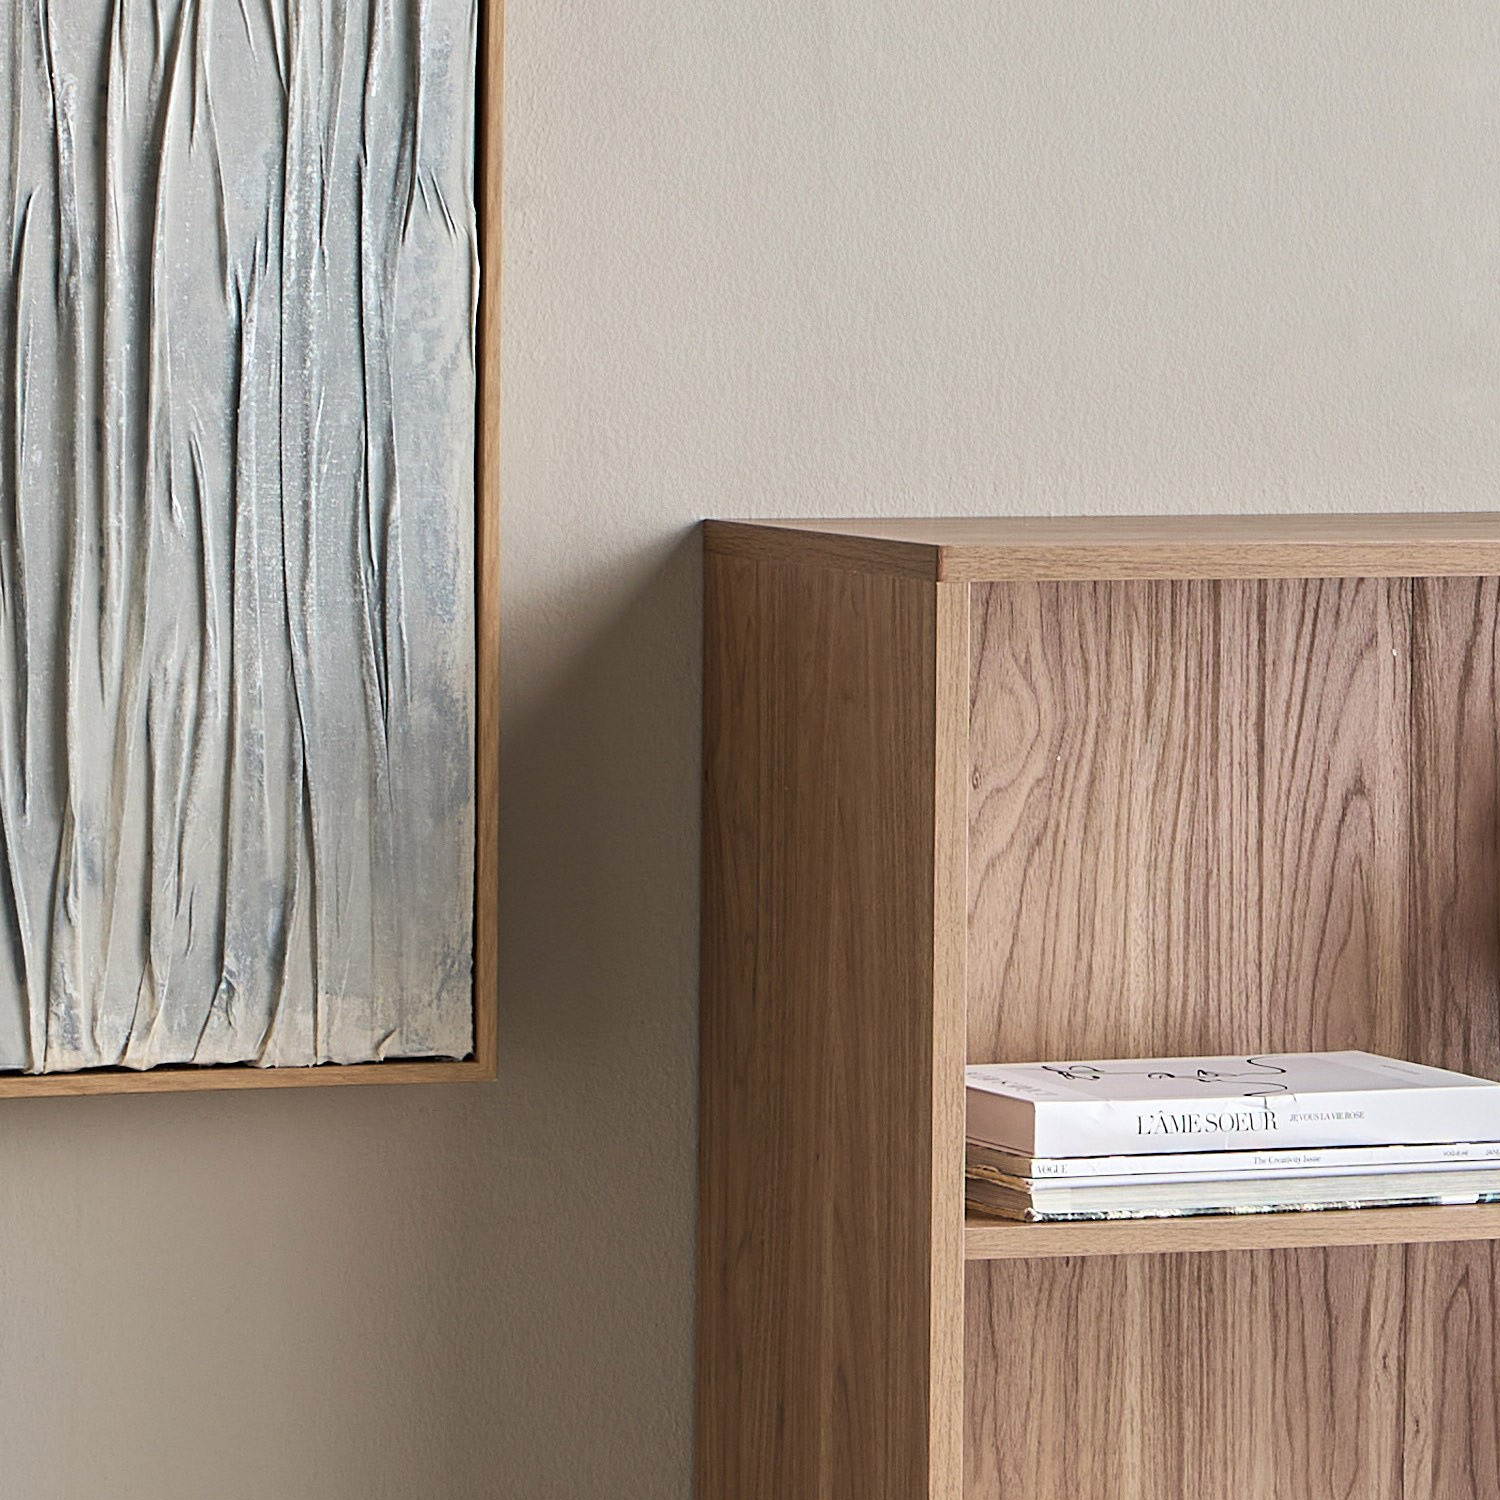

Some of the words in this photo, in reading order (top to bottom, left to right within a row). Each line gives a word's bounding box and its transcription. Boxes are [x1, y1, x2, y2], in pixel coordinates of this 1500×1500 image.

[1205, 1111, 1278, 1134] SOEUR
[1253, 1156, 1267, 1165] The
[1302, 1154, 1321, 1162] Issue
[1037, 1163, 1068, 1175] VOGUE
